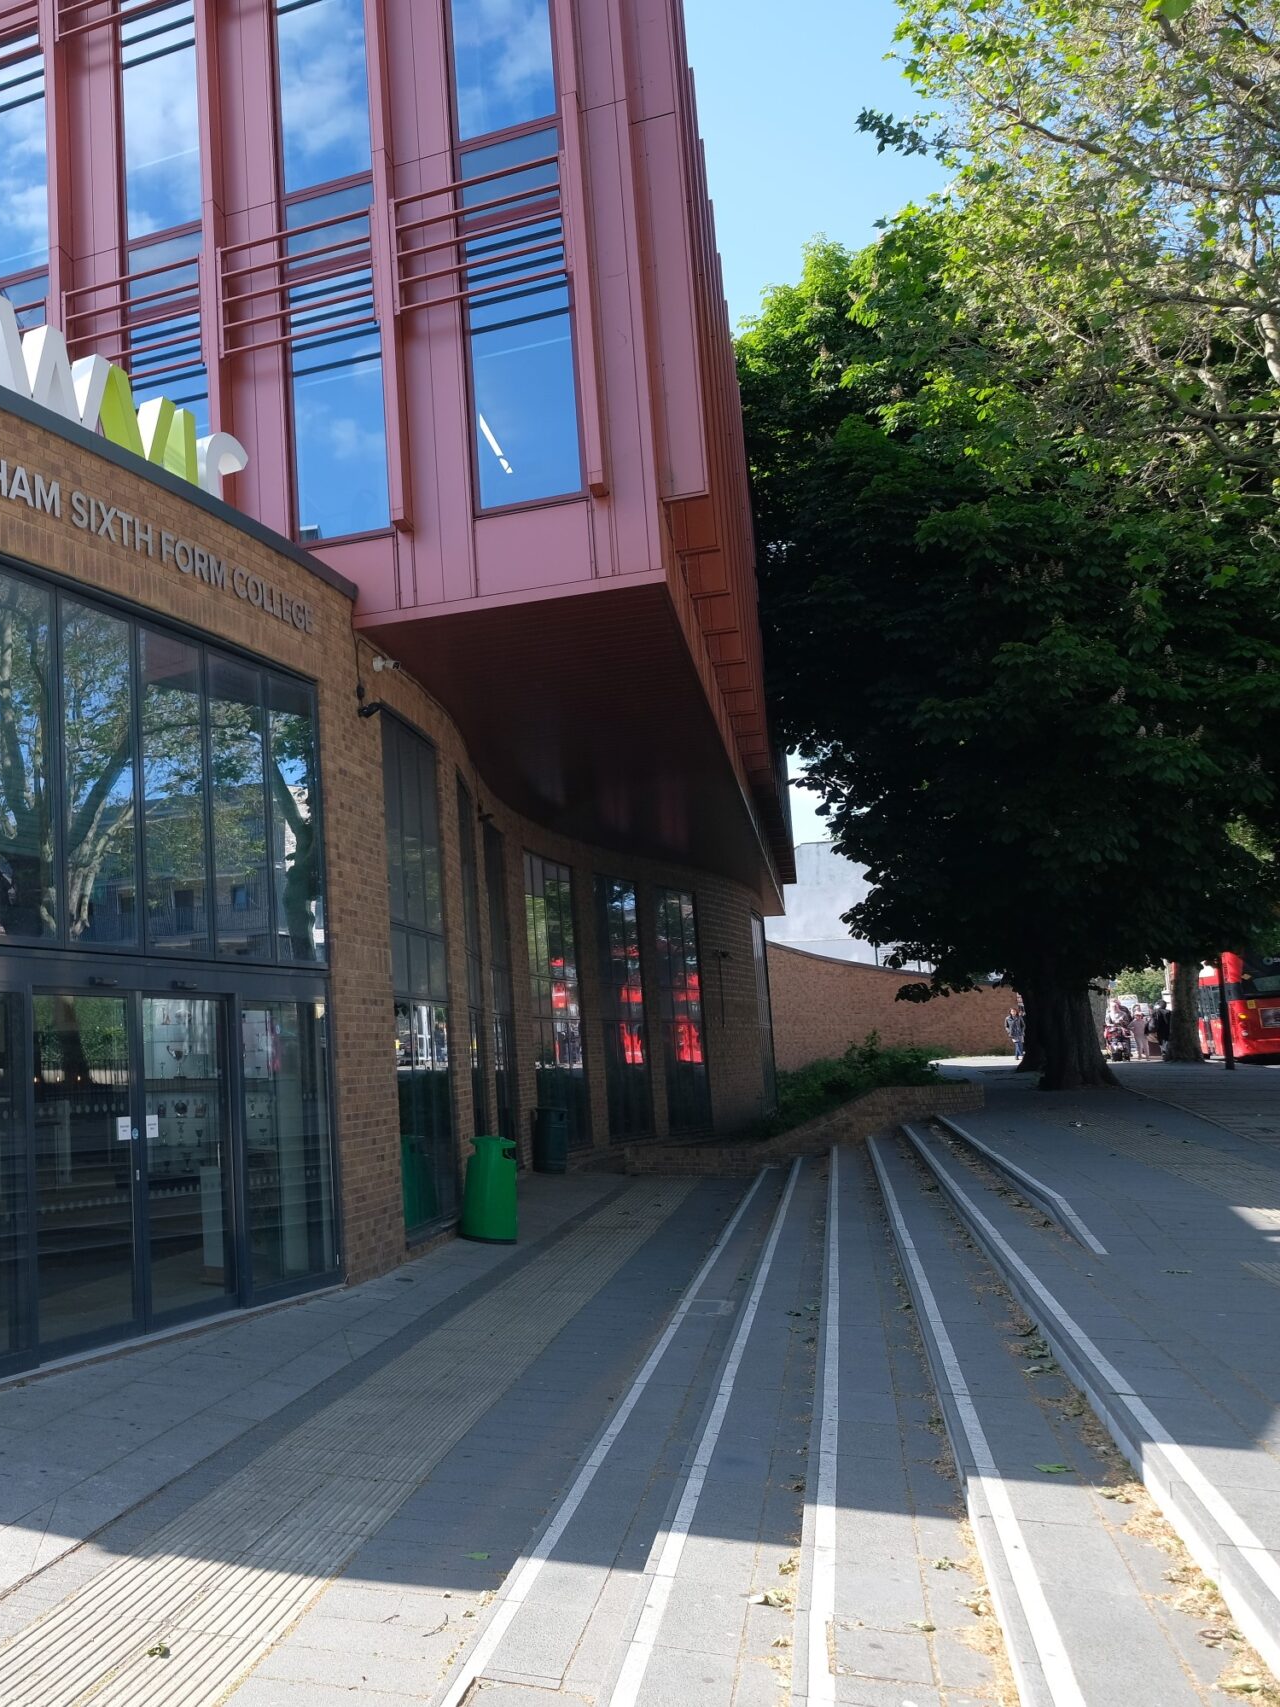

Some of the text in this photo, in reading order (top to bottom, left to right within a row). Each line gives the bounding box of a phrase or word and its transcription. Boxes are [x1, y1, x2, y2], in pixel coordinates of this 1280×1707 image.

[71, 491, 153, 558] SIXTH
[161, 530, 227, 591] FORM
[233, 566, 314, 636] COLLEGE
